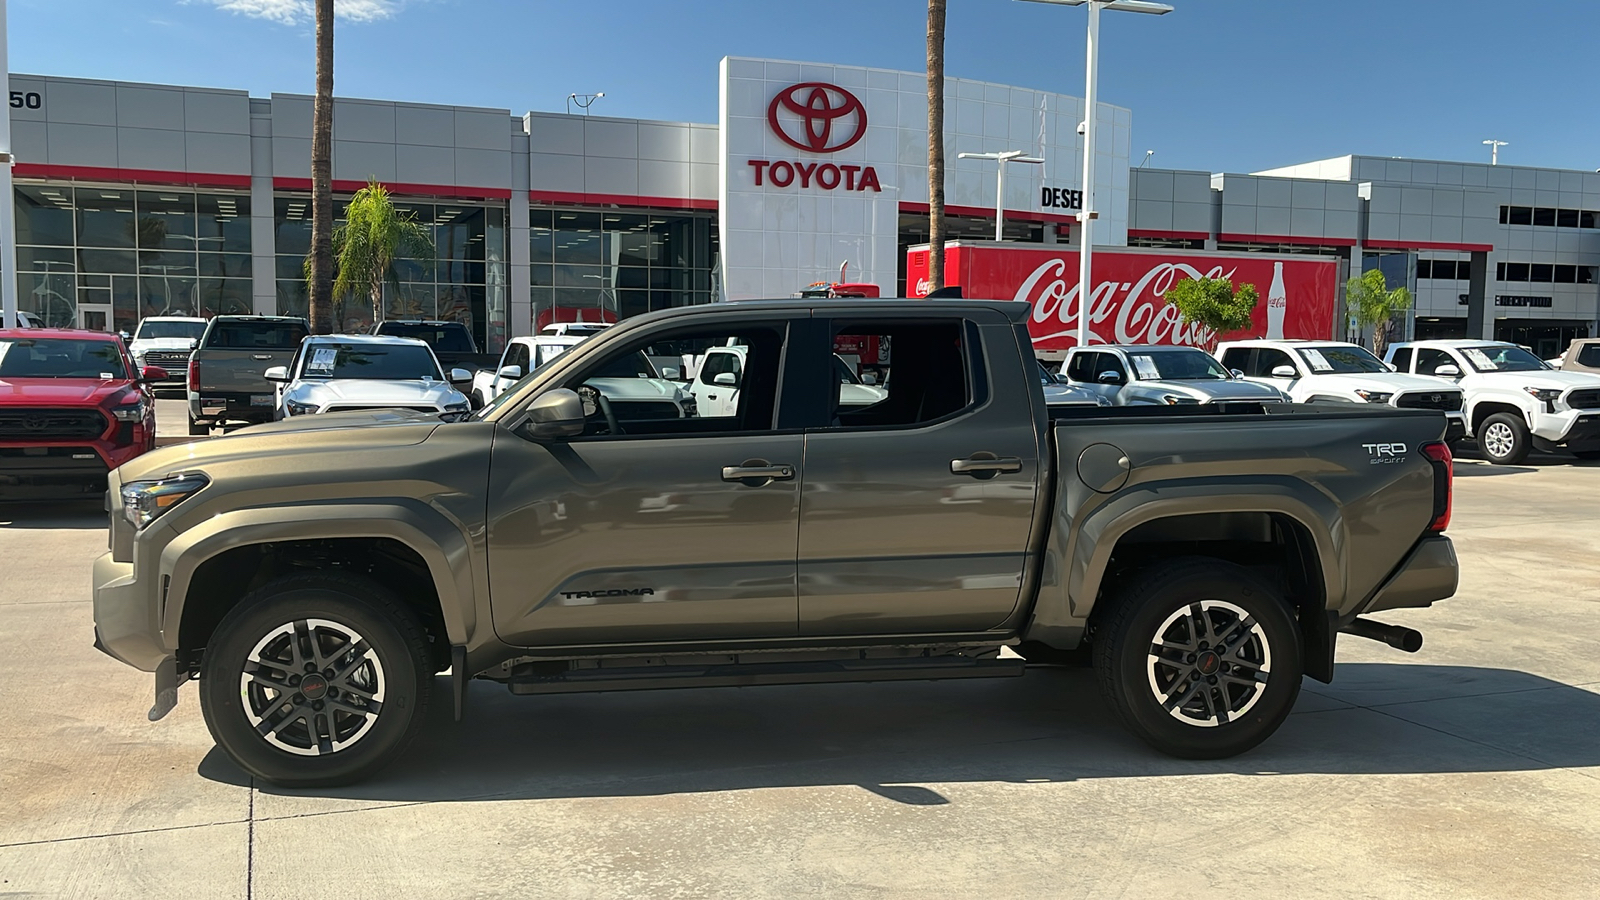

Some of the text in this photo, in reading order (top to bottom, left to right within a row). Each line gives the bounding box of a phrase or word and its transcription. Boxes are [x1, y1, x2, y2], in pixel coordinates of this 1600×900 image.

[9, 91, 42, 109] 50
[747, 159, 882, 192] TOYOTA
[1362, 442, 1408, 457] TRD
[1369, 457, 1406, 465] SPORT
[560, 587, 654, 599] TACOMA
